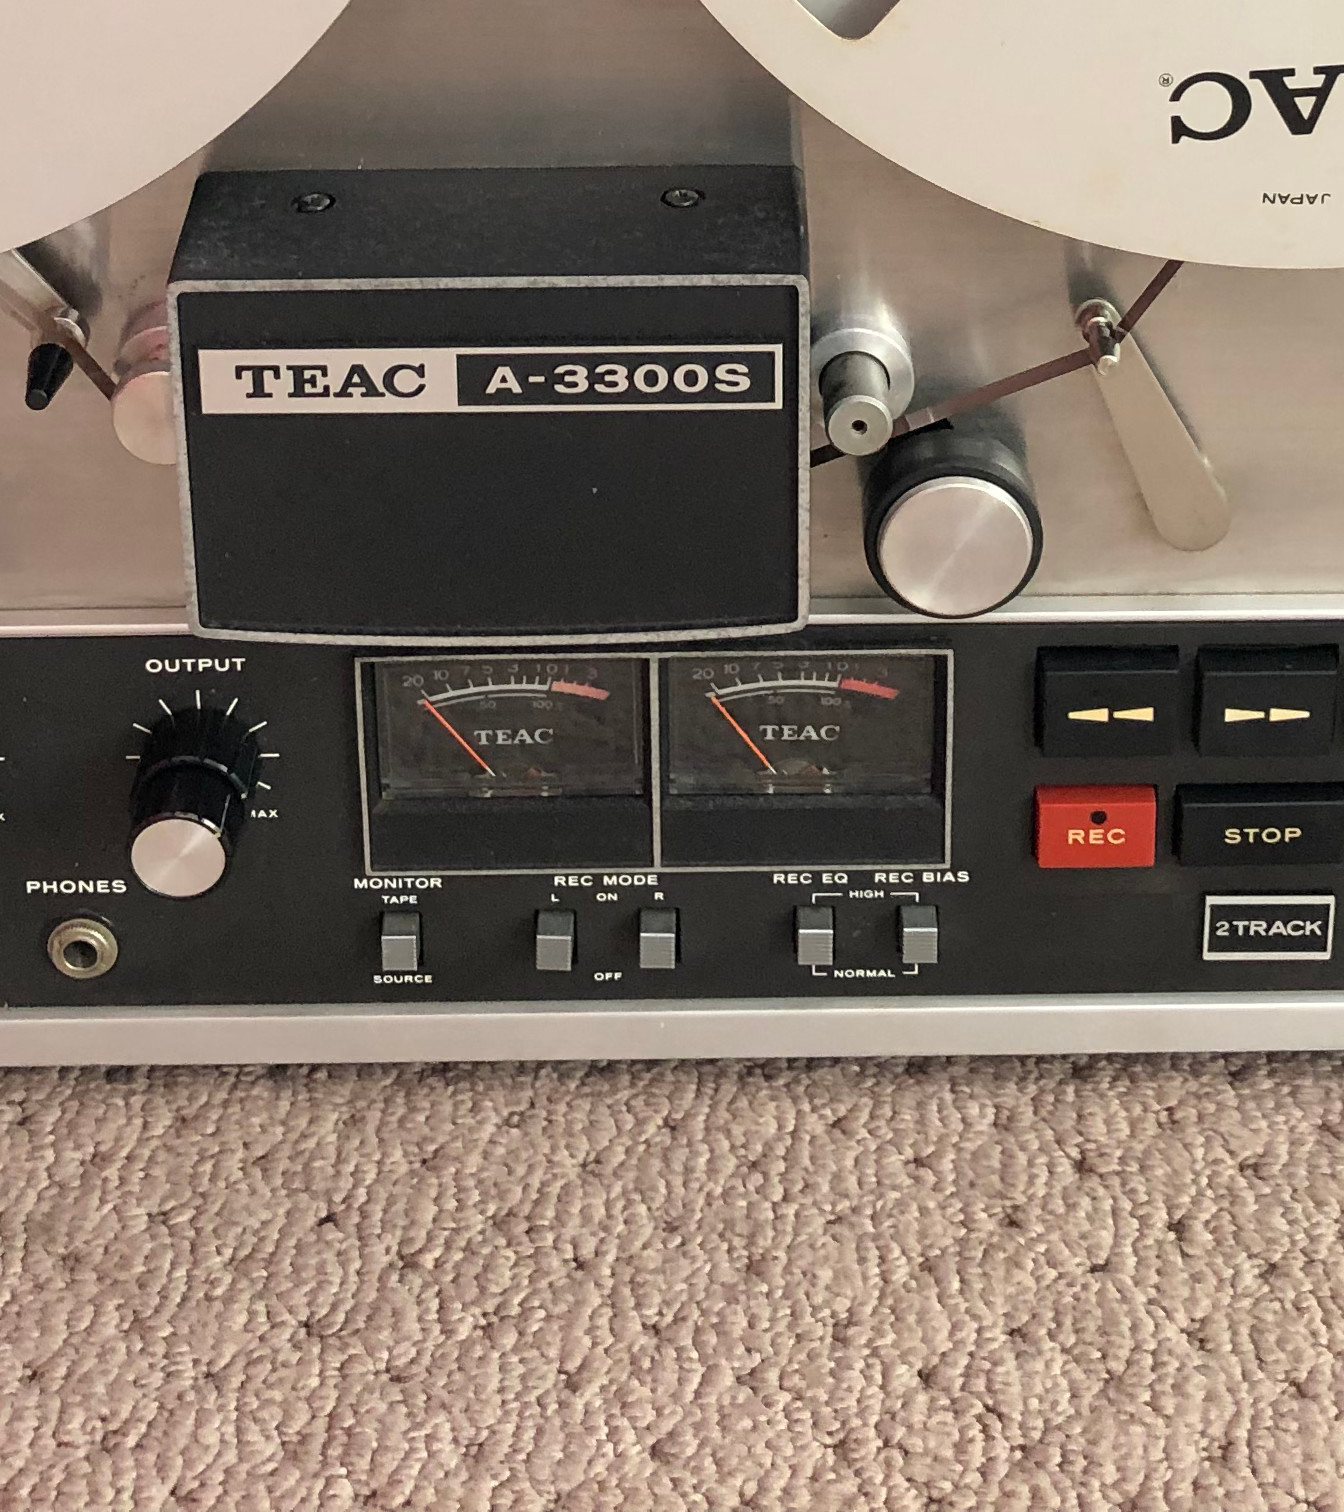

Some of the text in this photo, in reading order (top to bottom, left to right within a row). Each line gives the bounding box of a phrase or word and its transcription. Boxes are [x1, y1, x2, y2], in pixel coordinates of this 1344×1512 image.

[1263, 193, 1330, 204] JAPAN
[235, 364, 750, 398] TEAC A-3300S
[146, 658, 245, 672] OUTPUT
[474, 728, 554, 745] TEAC
[759, 725, 840, 741] TEAC
[1068, 829, 1125, 844] REC
[1225, 828, 1301, 843] STOP
[554, 875, 658, 886] REC MODE
[774, 873, 848, 884] REC EQ
[875, 871, 969, 883] REC BIAS
[27, 880, 126, 893] PHONES
[354, 878, 442, 889] MONITOR
[551, 892, 663, 902] L ON R
[849, 890, 884, 898] HIGH
[374, 975, 432, 983] SOURCE
